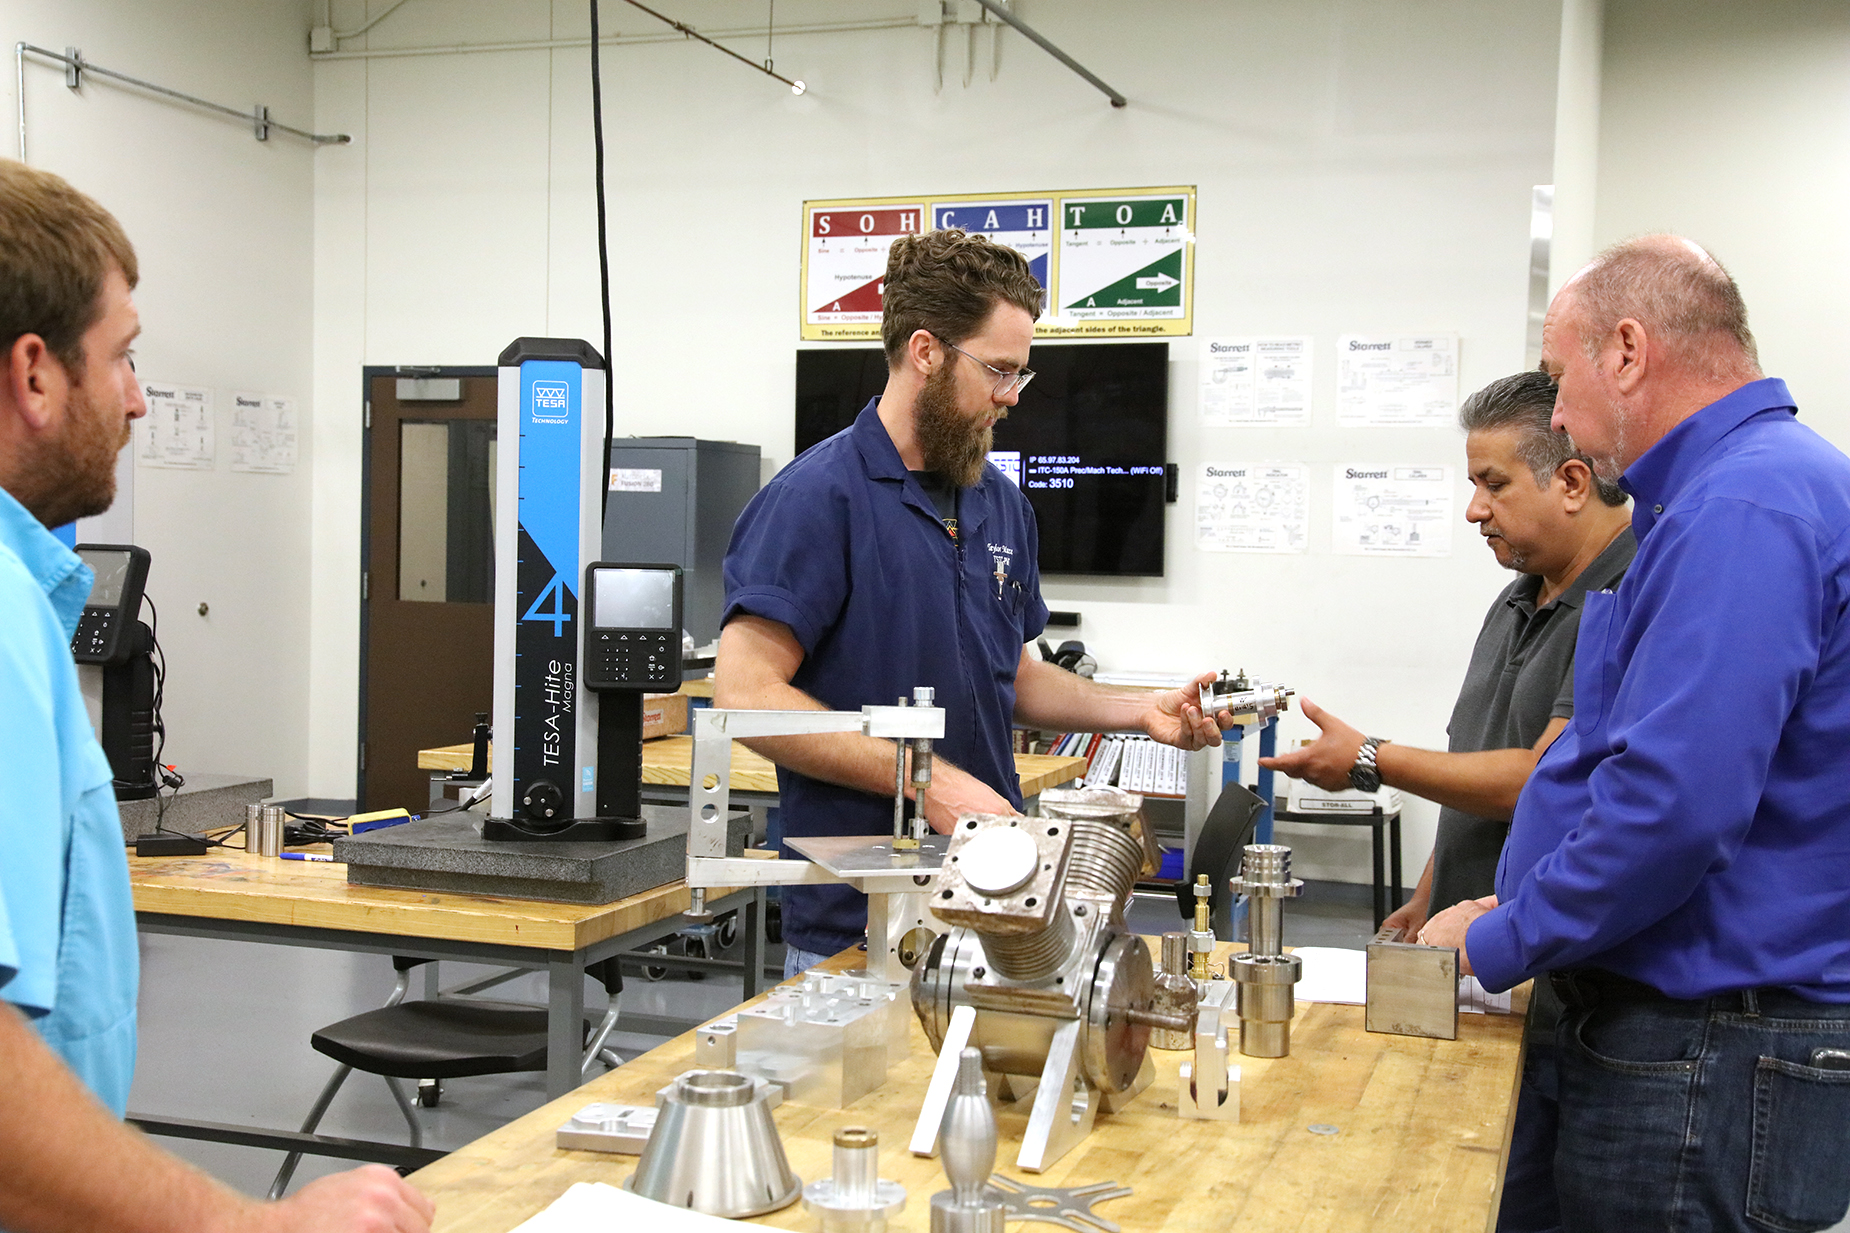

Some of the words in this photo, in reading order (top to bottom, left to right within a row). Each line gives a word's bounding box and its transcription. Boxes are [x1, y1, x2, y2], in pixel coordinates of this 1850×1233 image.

[942, 211, 955, 230] C
[984, 210, 1000, 228] A
[1027, 208, 1042, 227] H
[1070, 206, 1085, 226] T
[1116, 205, 1132, 224] O
[1160, 204, 1177, 223] A
[819, 216, 830, 234] S
[860, 214, 874, 232] O
[900, 213, 915, 231] H
[832, 301, 840, 311] A
[1086, 296, 1096, 307] A
[1133, 325, 1166, 333] triangle.
[1210, 342, 1250, 353] Starrett
[1348, 340, 1391, 352] Starrett
[536, 399, 566, 408] TESA
[1206, 466, 1246, 478] Starrett
[1346, 468, 1388, 479] Starrett
[1028, 480, 1048, 488] Code:
[1049, 478, 1074, 488] 3510
[521, 573, 572, 637] 4
[562, 662, 572, 713] Magna
[543, 659, 562, 767] TESA-Hite
